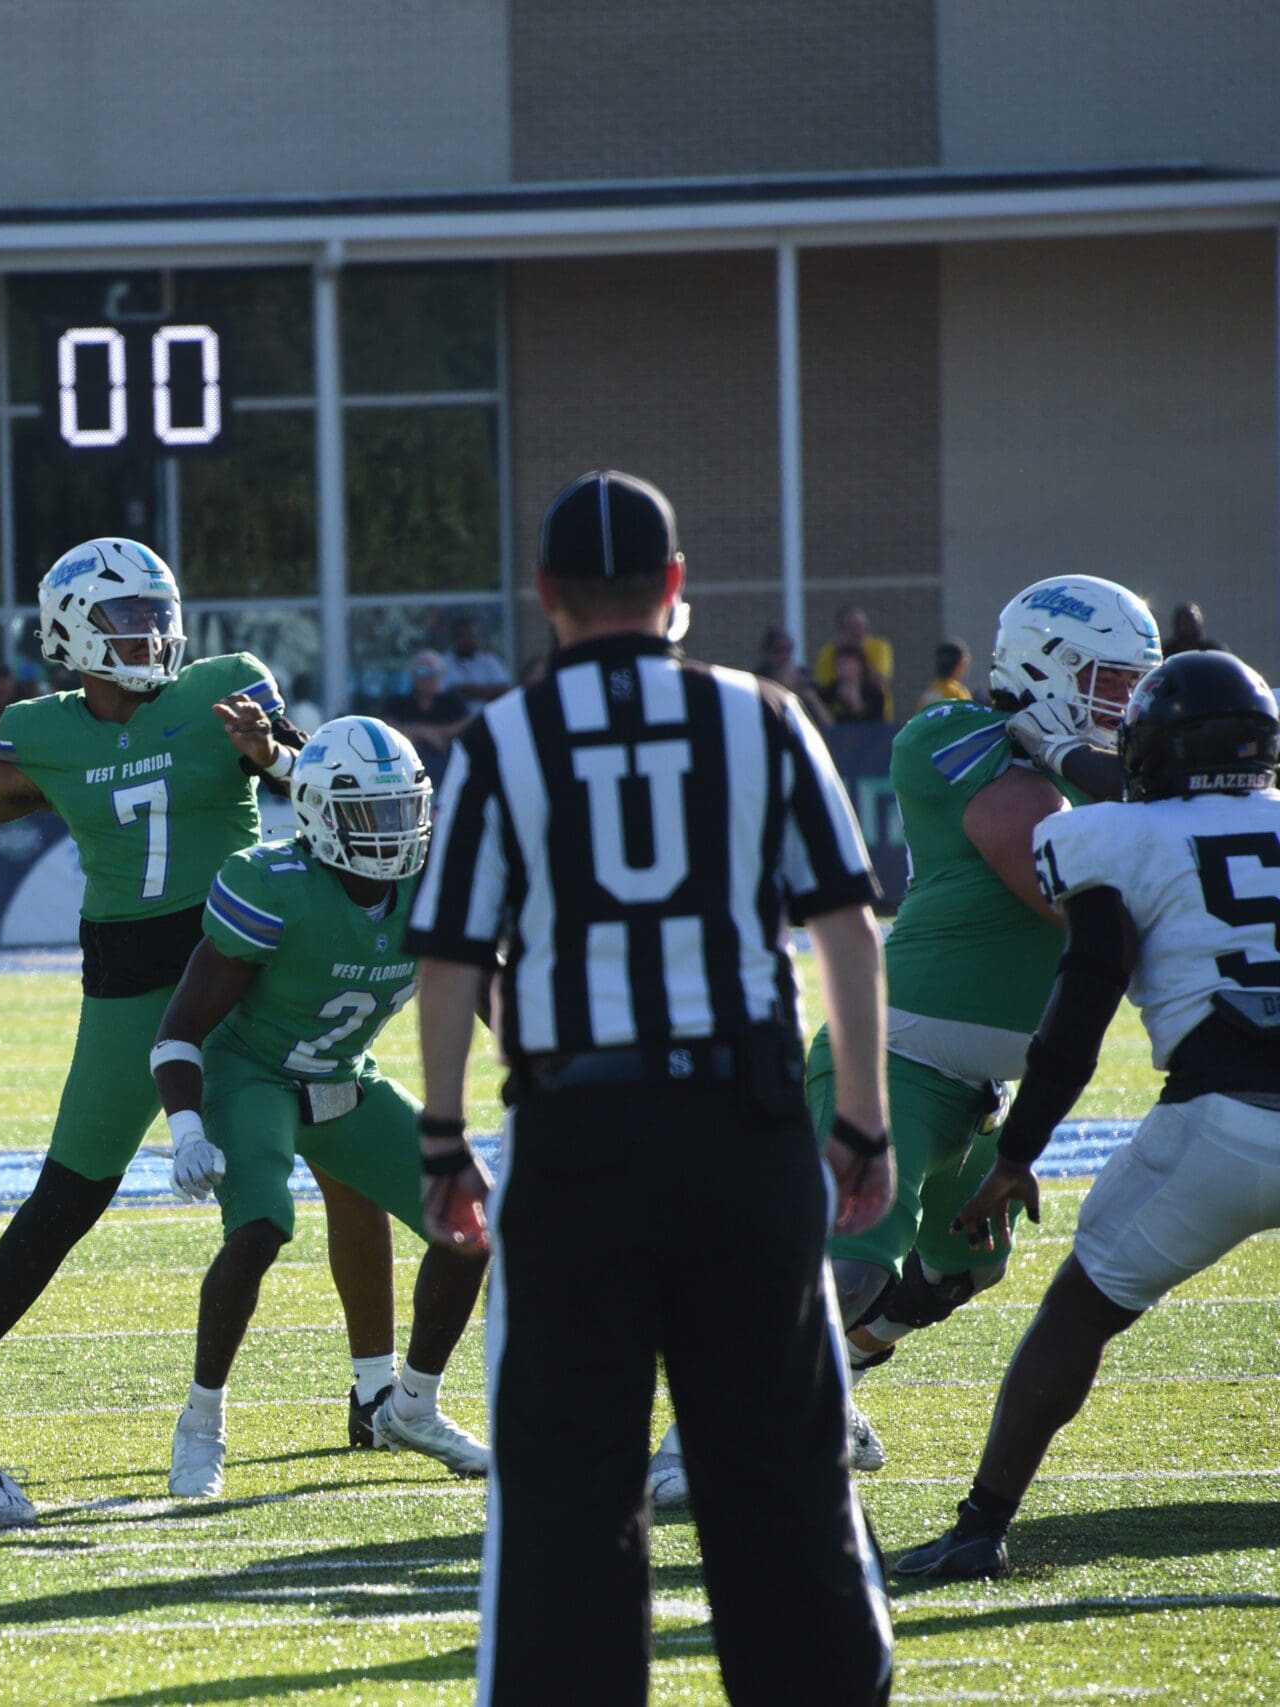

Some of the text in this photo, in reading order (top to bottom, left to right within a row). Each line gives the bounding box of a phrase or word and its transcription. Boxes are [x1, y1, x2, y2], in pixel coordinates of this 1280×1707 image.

[57, 324, 220, 447] 00
[86, 752, 173, 784] WEST FLORIDA
[1189, 774, 1268, 790] BLAZERS
[110, 775, 170, 900] 7
[571, 738, 694, 904] U
[331, 961, 415, 982] WEST FLORIDA
[282, 980, 418, 1078] 21
